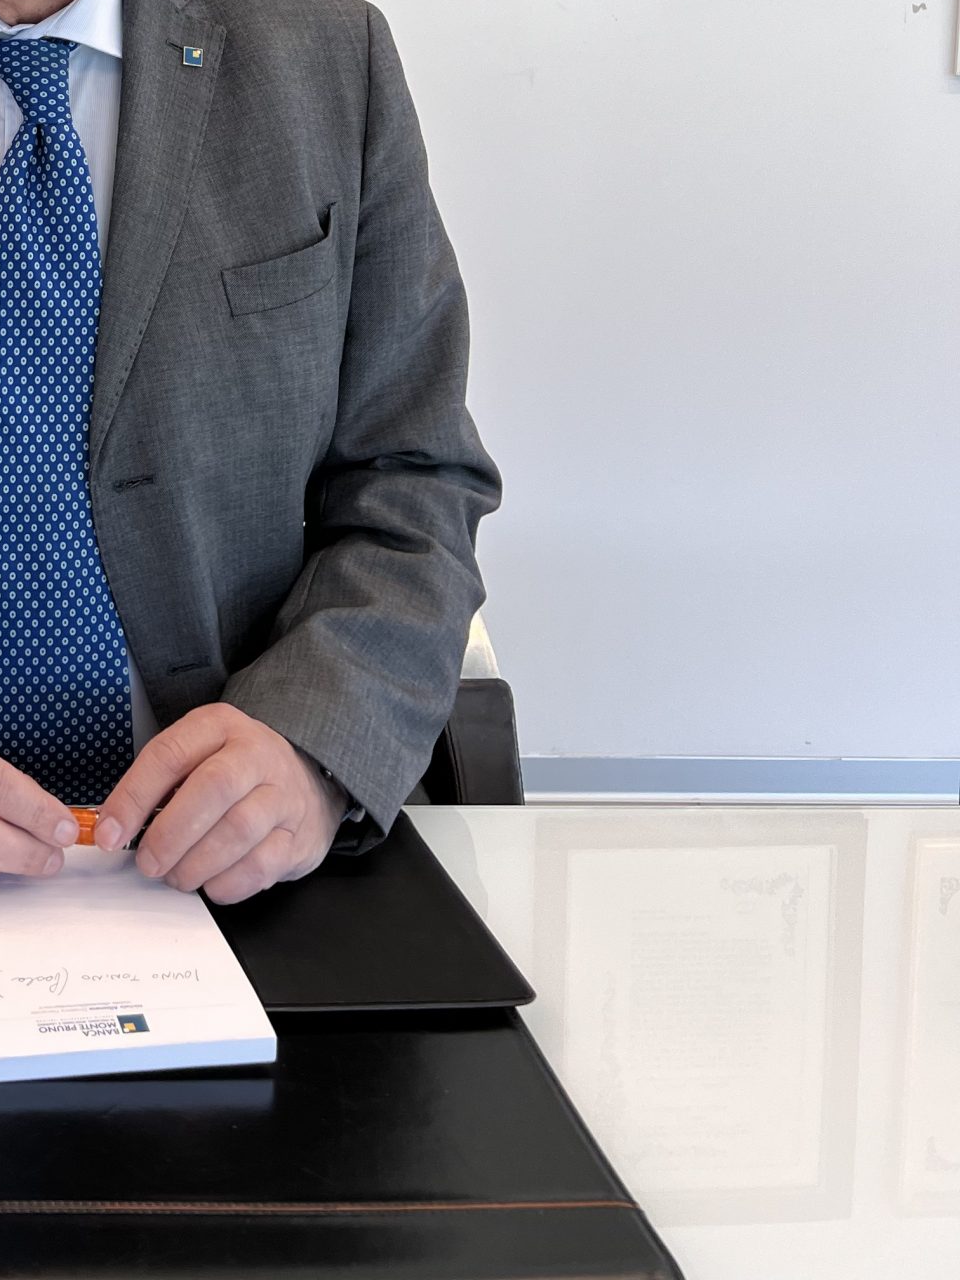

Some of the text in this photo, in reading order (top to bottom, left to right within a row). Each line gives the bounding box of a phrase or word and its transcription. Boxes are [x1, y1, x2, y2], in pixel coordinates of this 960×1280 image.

[38, 1023, 76, 1034] PRUNO
[78, 1020, 117, 1031] MONTE
[81, 1027, 120, 1037] BANCA
